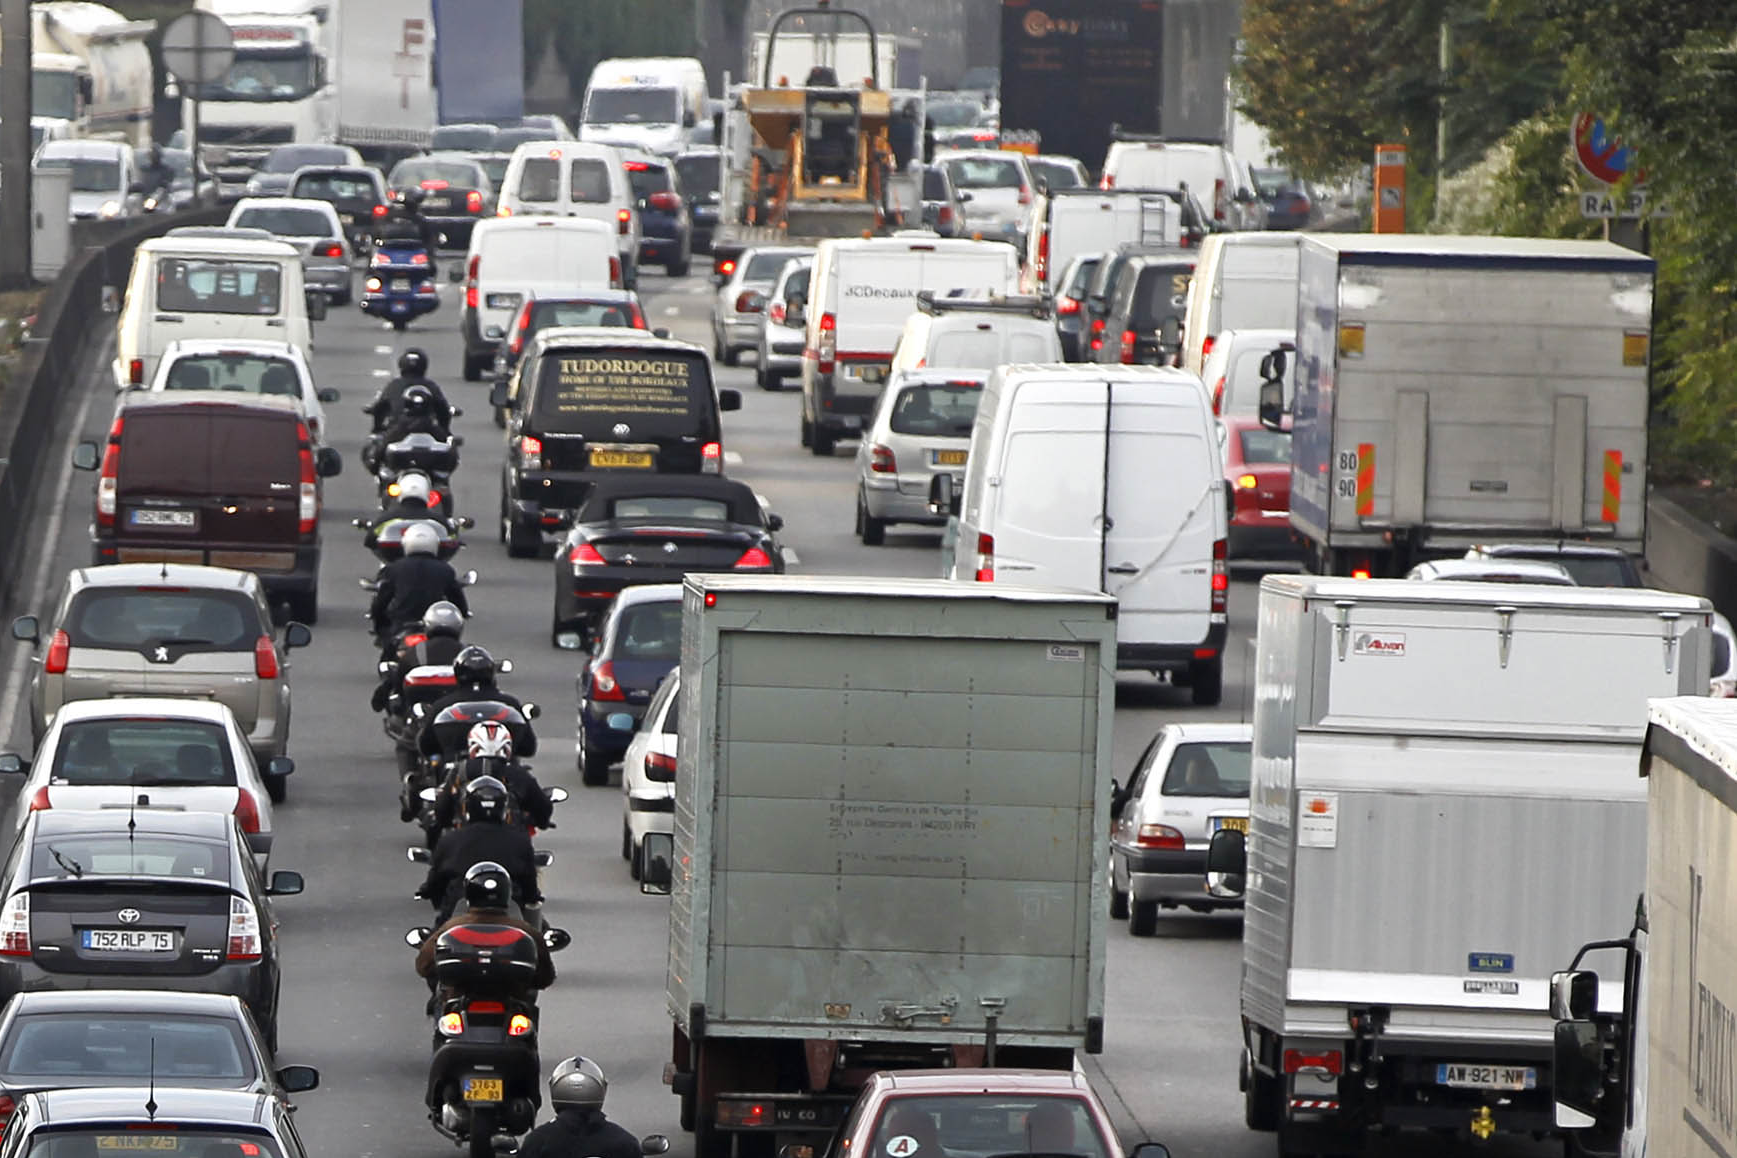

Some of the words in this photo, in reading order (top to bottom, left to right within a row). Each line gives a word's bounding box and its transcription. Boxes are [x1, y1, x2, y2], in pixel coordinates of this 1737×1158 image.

[559, 360, 689, 376] TUDORDOGUE
[1340, 452, 1357, 470] 80
[1339, 479, 1356, 497] 90
[94, 933, 120, 947] 752
[152, 935, 169, 949] 75
[894, 1138, 909, 1153] A
